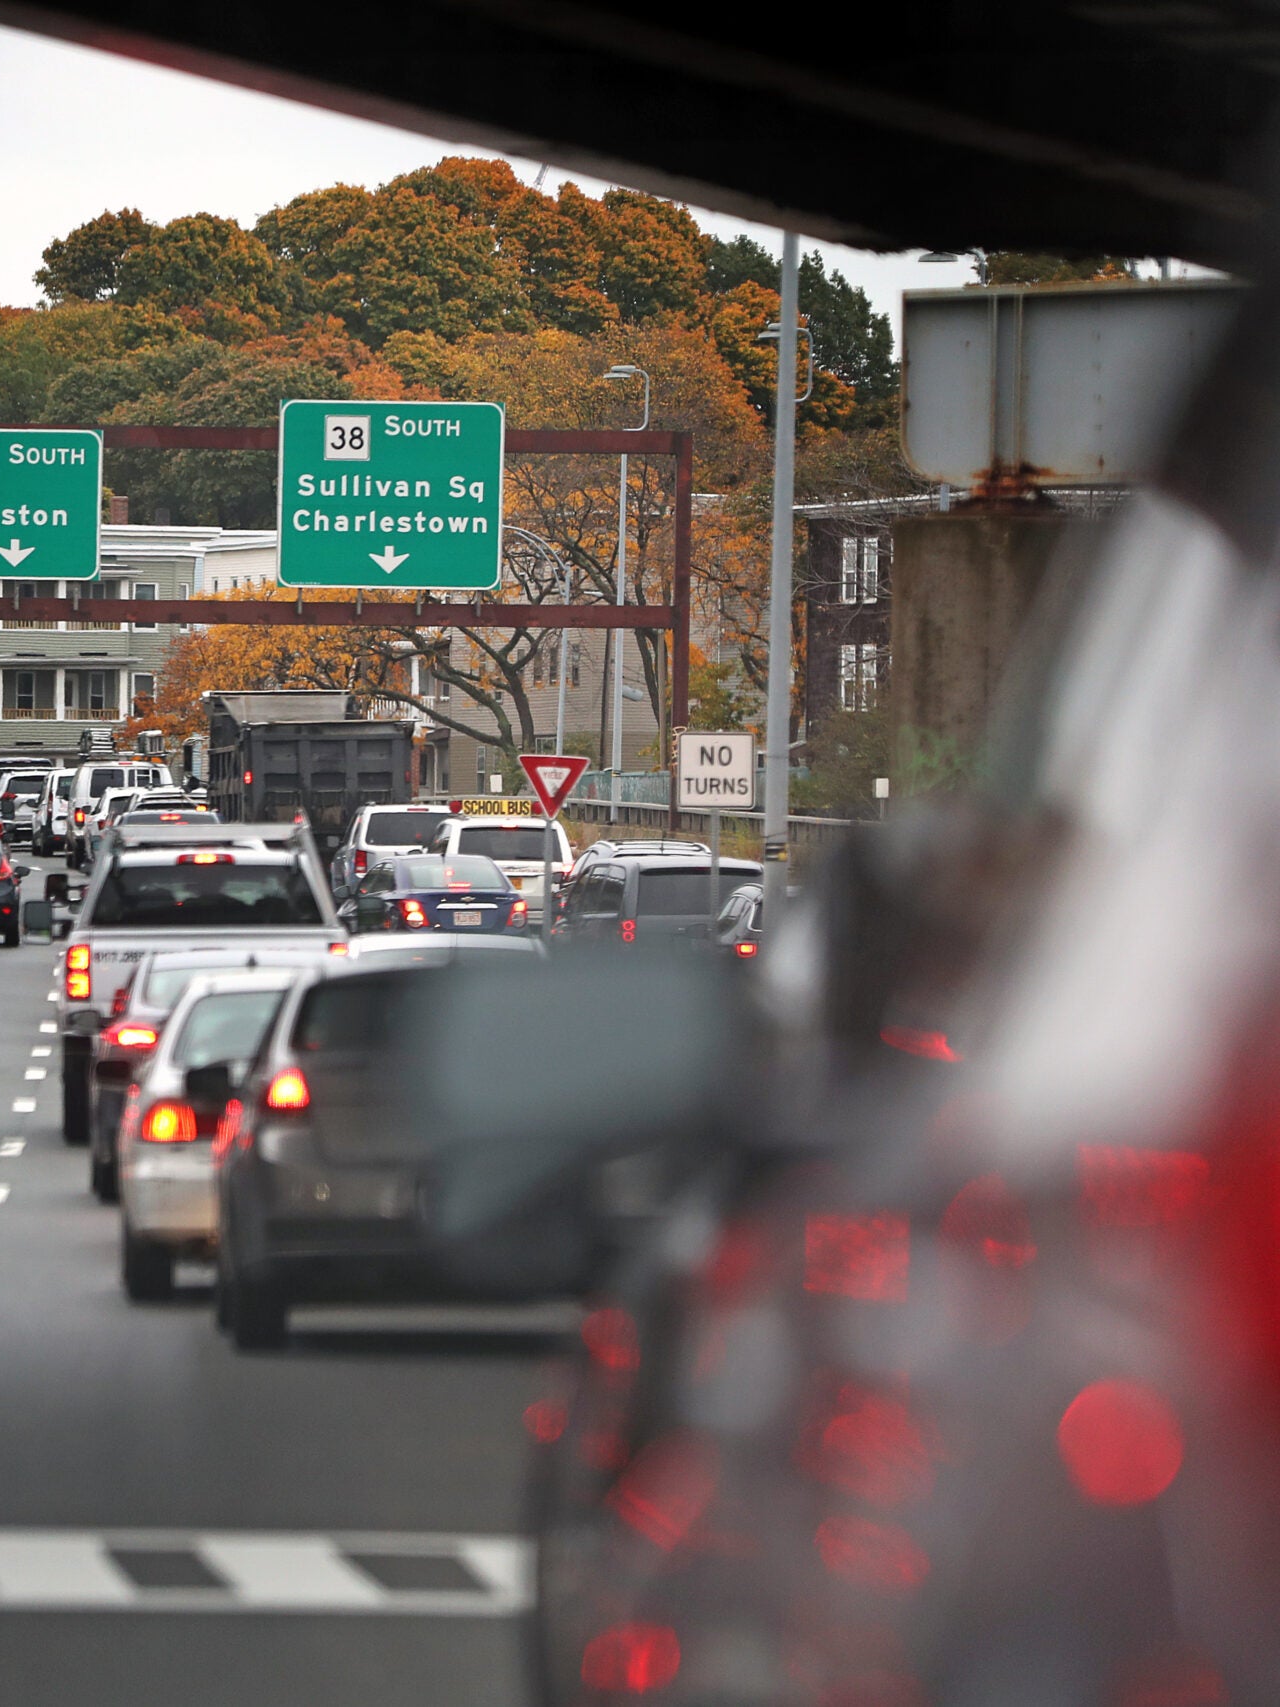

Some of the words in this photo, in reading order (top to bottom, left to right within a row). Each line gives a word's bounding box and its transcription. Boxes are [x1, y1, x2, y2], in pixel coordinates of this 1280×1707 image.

[384, 415, 461, 437] SOUTH
[331, 426, 365, 450] 38
[8, 443, 86, 465] SOUTH
[297, 473, 431, 497] Sullivan
[448, 475, 485, 503] Sq
[292, 509, 488, 533] Charlestown
[700, 745, 733, 766] NO
[684, 777, 749, 795] TURNS
[463, 800, 506, 815] SCHOOL
[507, 801, 530, 816] BUS
